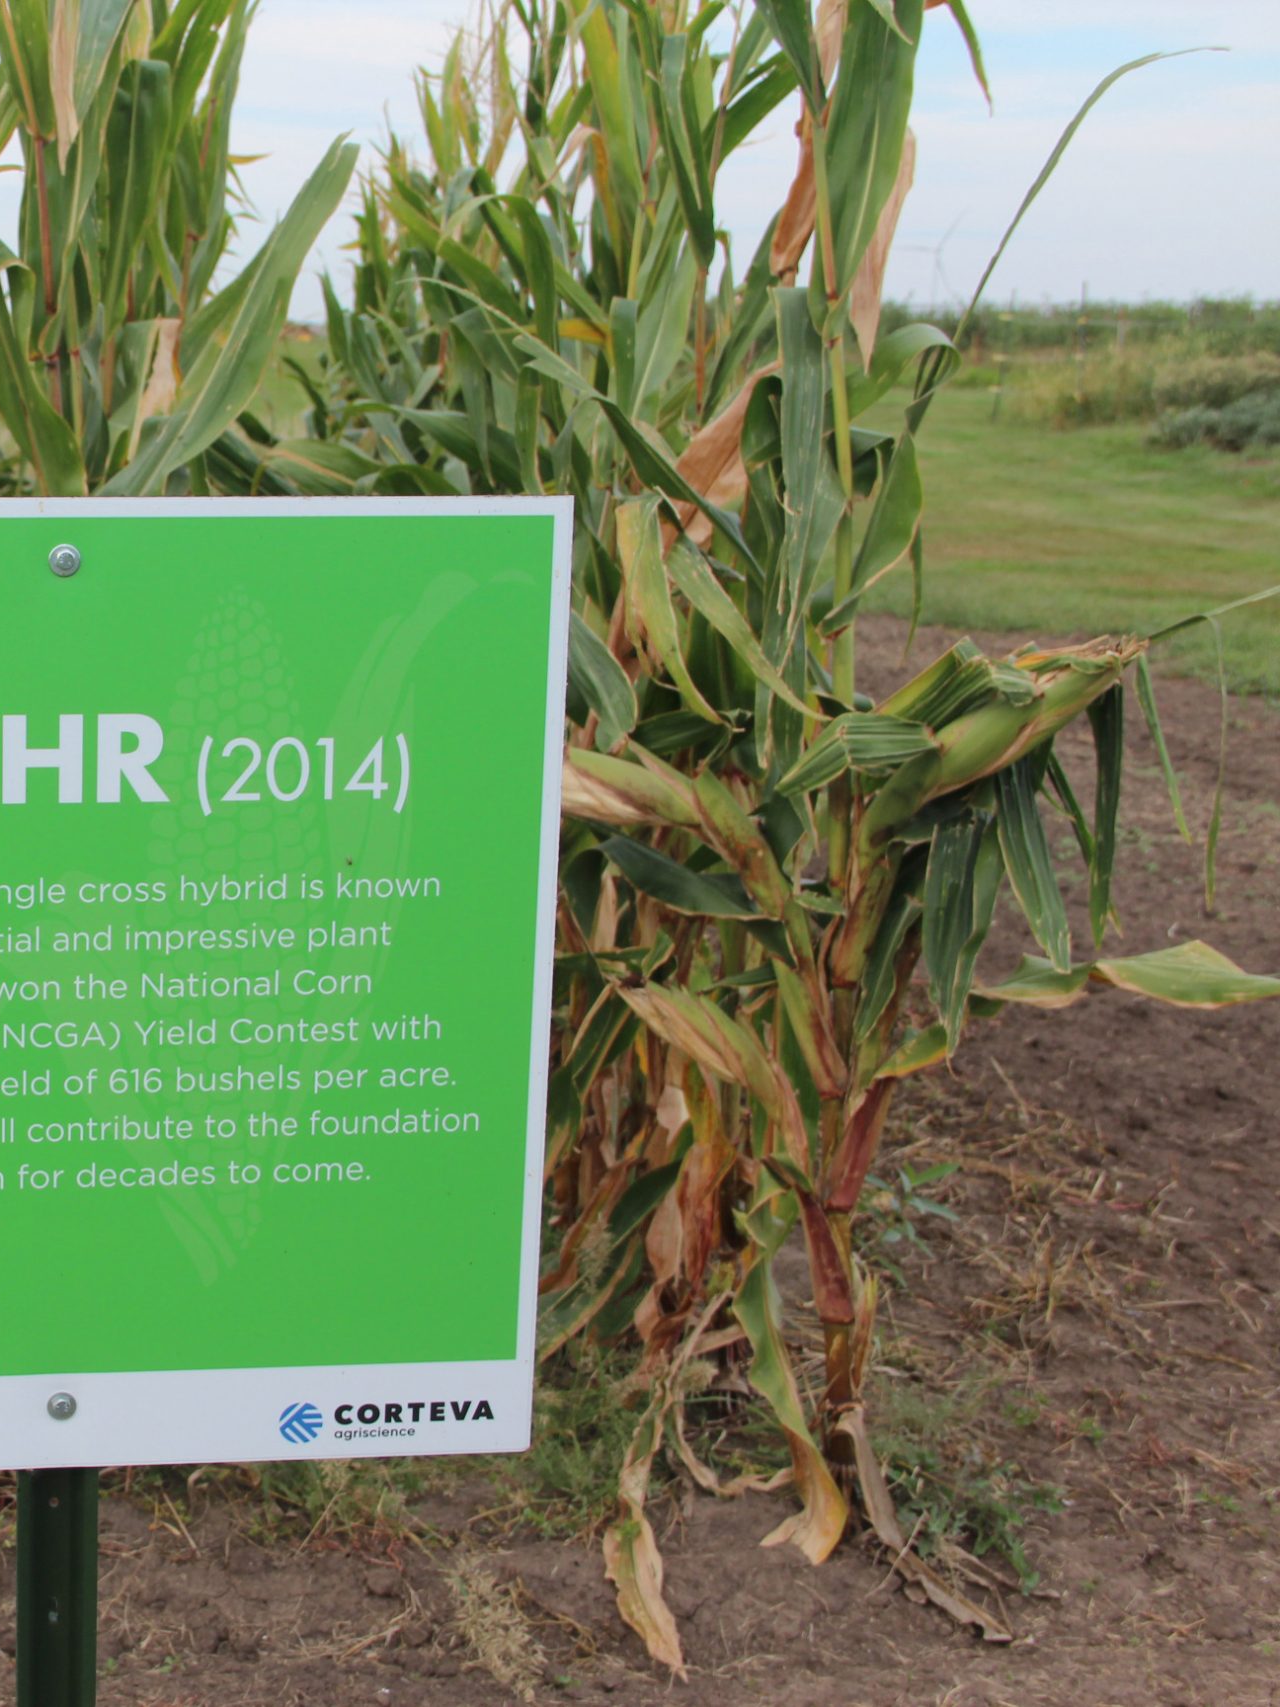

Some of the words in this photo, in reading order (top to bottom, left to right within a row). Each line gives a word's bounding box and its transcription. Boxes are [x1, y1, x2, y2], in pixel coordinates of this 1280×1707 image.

[196, 732, 411, 817] (2014)
[78, 881, 167, 904] cross
[180, 873, 288, 907] hybrid
[301, 873, 324, 900] is
[336, 871, 441, 899] known
[52, 924, 113, 953] and
[125, 922, 296, 956] impressive
[307, 920, 392, 953] plant
[73, 973, 129, 1000] the
[140, 969, 280, 999] National
[292, 969, 372, 996] Corn
[133, 1018, 217, 1046] Yield
[229, 1017, 359, 1044] Contest
[372, 1014, 441, 1041] with
[63, 1067, 98, 1095] of
[108, 1067, 163, 1095] 616
[175, 1064, 301, 1093] bushels
[314, 1068, 369, 1094] per
[379, 1067, 456, 1088] acre.
[27, 1114, 194, 1143] contribute
[204, 1114, 237, 1139] to
[247, 1111, 298, 1138] the
[309, 1107, 480, 1136] foundation
[17, 1163, 65, 1190] for
[76, 1160, 216, 1188] decades
[227, 1160, 261, 1185] to
[273, 1162, 370, 1184] come.
[334, 1400, 494, 1425] CORTEVA
[333, 1427, 416, 1441] agriscience
